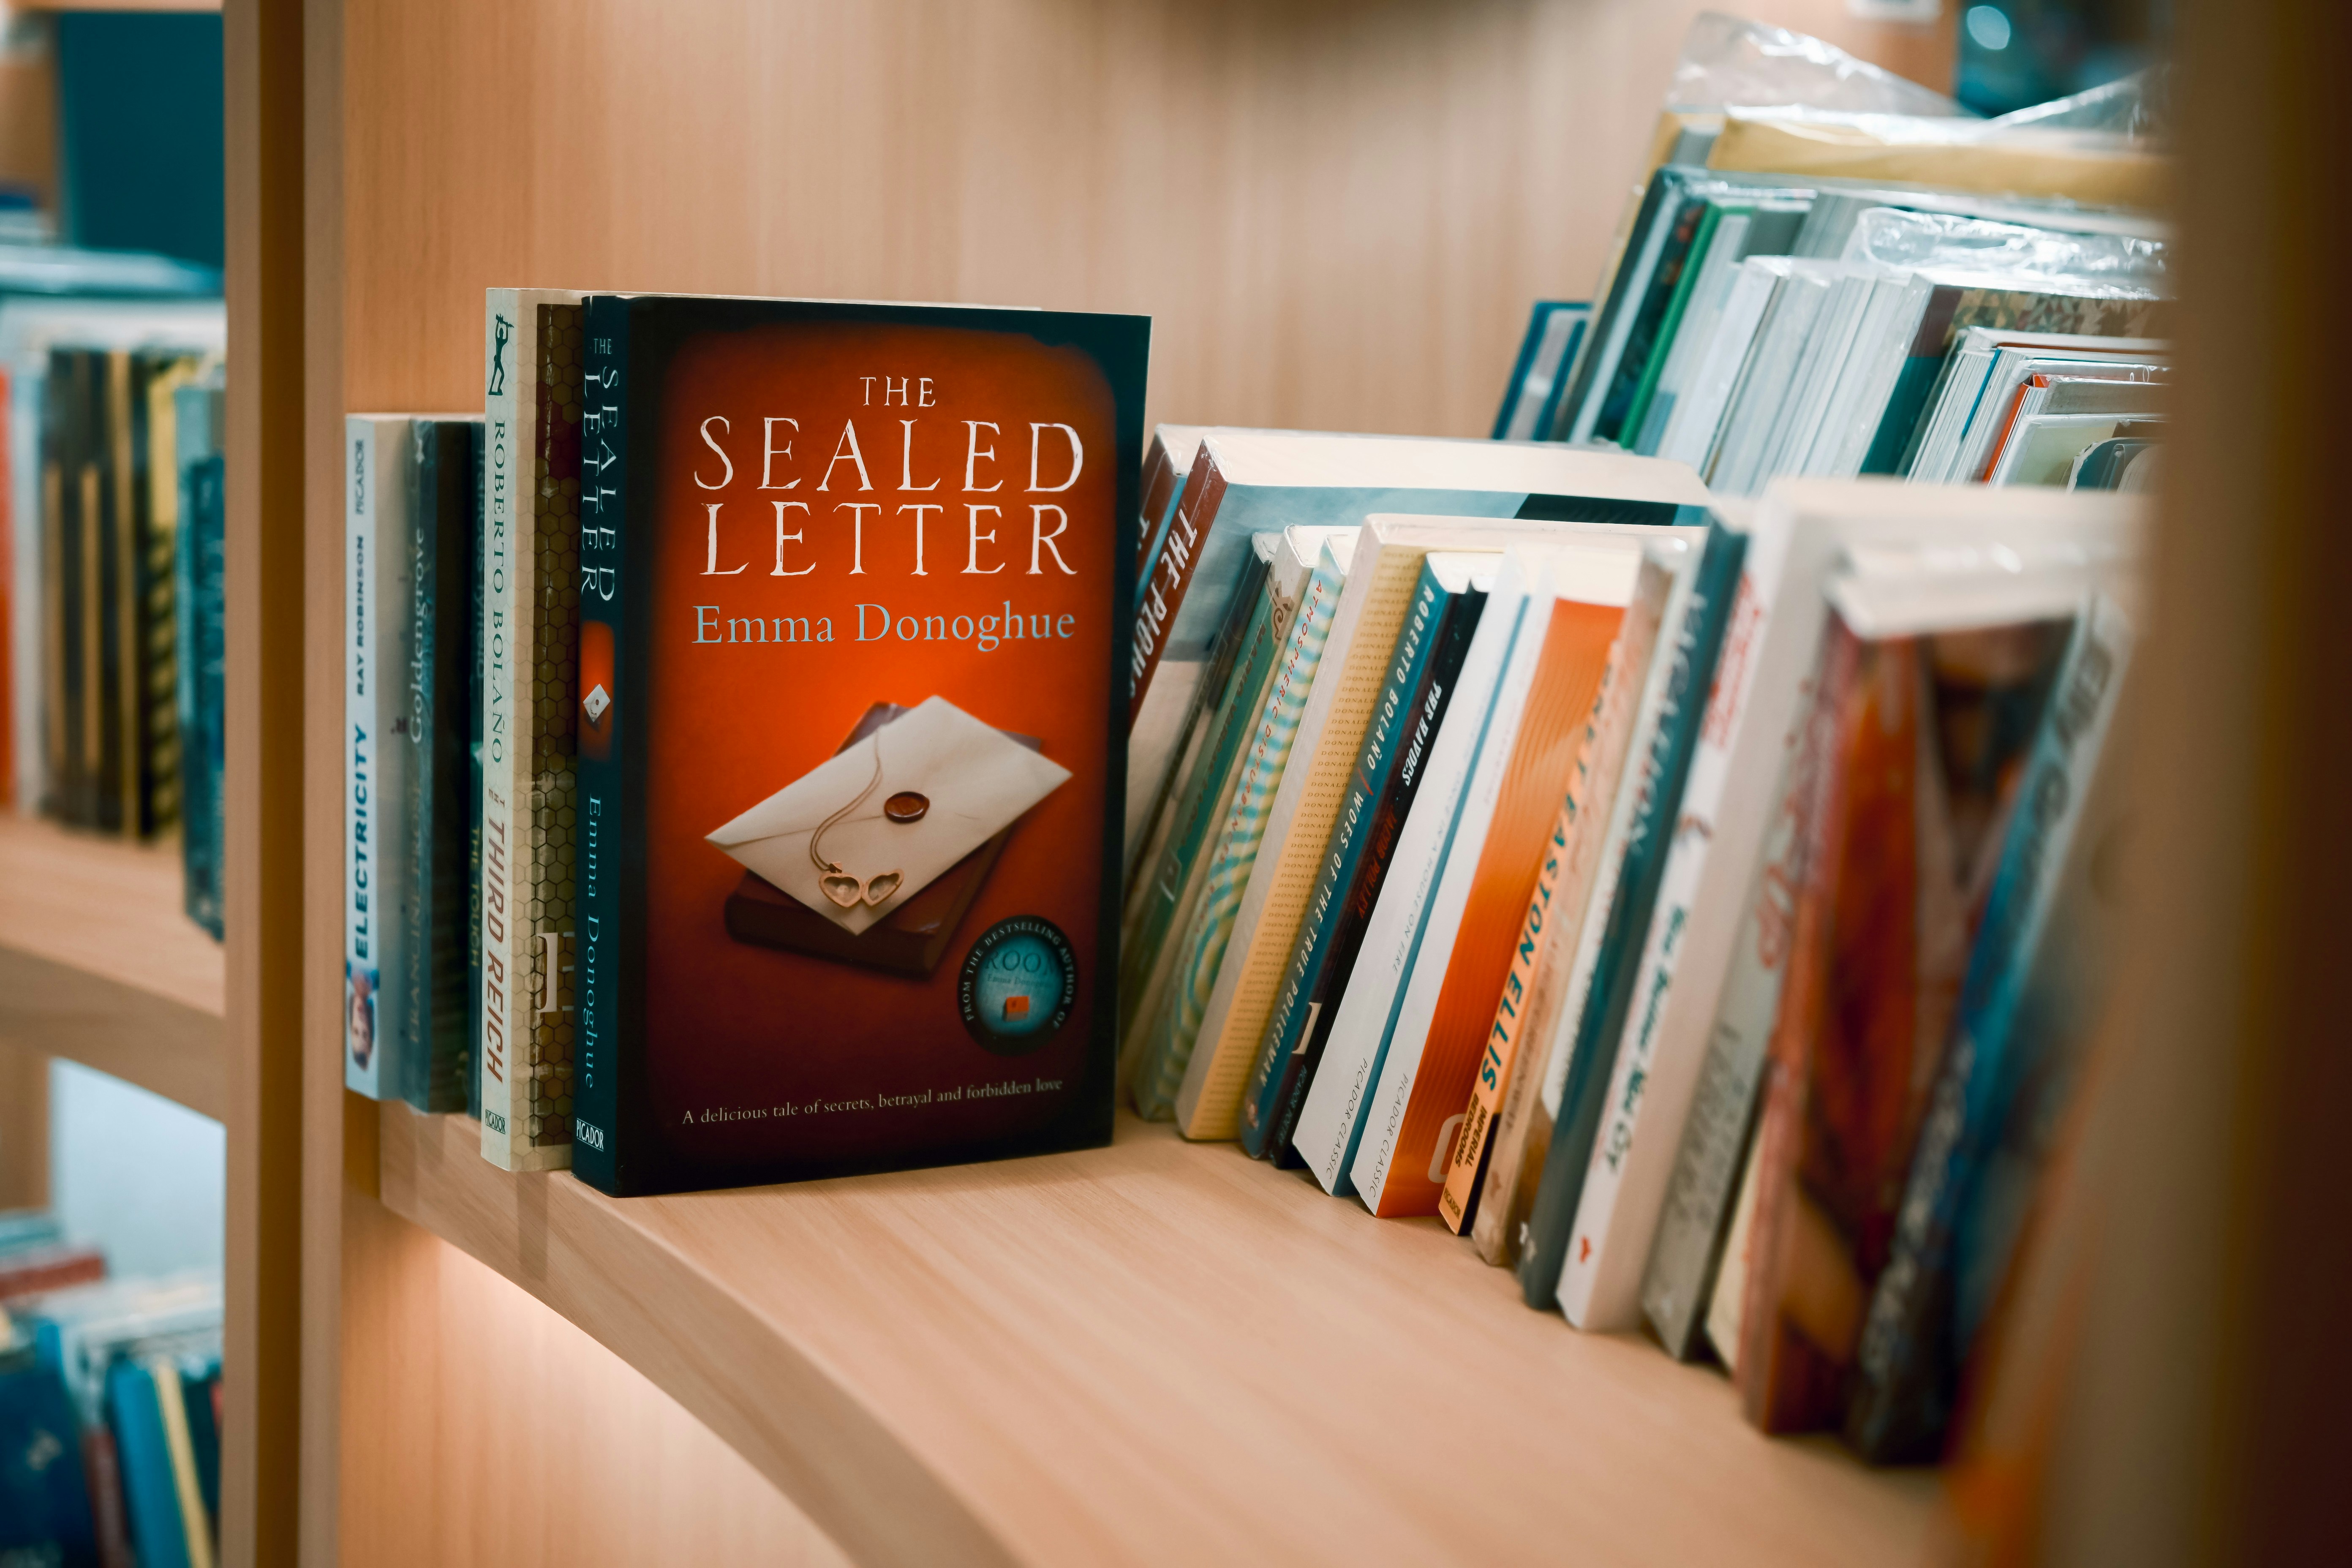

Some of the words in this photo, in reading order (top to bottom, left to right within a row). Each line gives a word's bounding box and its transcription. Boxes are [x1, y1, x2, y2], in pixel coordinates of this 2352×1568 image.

[593, 338, 612, 355] THE
[859, 376, 936, 407] THE
[581, 371, 601, 594] LETTER
[600, 365, 619, 602] SEALED
[694, 416, 1084, 493] SEALED
[493, 419, 505, 595] ROBERTO
[699, 501, 1078, 577] LETTER
[1160, 508, 1198, 590] THE
[356, 534, 365, 647] ROBINSON
[409, 526, 428, 744] Goldengrove
[691, 604, 836, 644] Emma
[854, 600, 1076, 652] Donoghue
[1129, 577, 1168, 700] PLOU
[1271, 579, 1322, 719] ATMOSPHERIC
[1396, 585, 1435, 684] ROBERTO
[356, 652, 365, 696] RAY
[492, 608, 506, 764] BOLAÑO
[1427, 679, 1443, 721] THE
[1367, 688, 1399, 770] BOLAÑO
[1401, 715, 1429, 787] HAVOCS
[488, 788, 505, 808] THE
[1340, 791, 1364, 849] WOES
[354, 724, 369, 960] ELECTRICITY
[588, 795, 601, 898] Emma
[1330, 852, 1342, 882] OF
[487, 819, 505, 945] THIRD
[1315, 884, 1332, 924] THE
[1413, 858, 1434, 912] HOUSE
[1519, 792, 1577, 966] EASTON
[983, 921, 1062, 947] BESTSELLING
[1296, 926, 1318, 978] TRUE
[1392, 940, 1406, 975] FIRE
[1404, 913, 1414, 939] ON
[966, 948, 984, 975] THE
[1059, 947, 1075, 1005] AUTHOR
[487, 959, 504, 1084] REICH
[583, 915, 600, 1089] Donoghue
[962, 981, 975, 1021] FROM
[1482, 970, 1523, 1092] ELLIS
[1259, 979, 1298, 1087] POLICEMAN
[682, 1110, 694, 1124] A
[700, 1106, 768, 1123] delicious
[773, 1102, 798, 1117] tale
[804, 1099, 820, 1114] of
[824, 1097, 874, 1113] secrets,
[879, 1089, 932, 1111] betrayal
[937, 1086, 962, 1102] and
[966, 1079, 1031, 1100] forbidden
[1035, 1078, 1063, 1093] love
[1345, 1057, 1368, 1120] PICADOR
[1386, 1073, 1409, 1137] PICADOR
[485, 1109, 506, 1135] PICADOR
[576, 1117, 604, 1152] PICADOR
[1326, 1122, 1347, 1179] CLASSIC
[1455, 1092, 1479, 1168] BEDROOMS
[1465, 1105, 1488, 1167] IMPERIAL
[1369, 1139, 1390, 1198] CLASSIC
[1443, 1187, 1461, 1220] PICADOR
